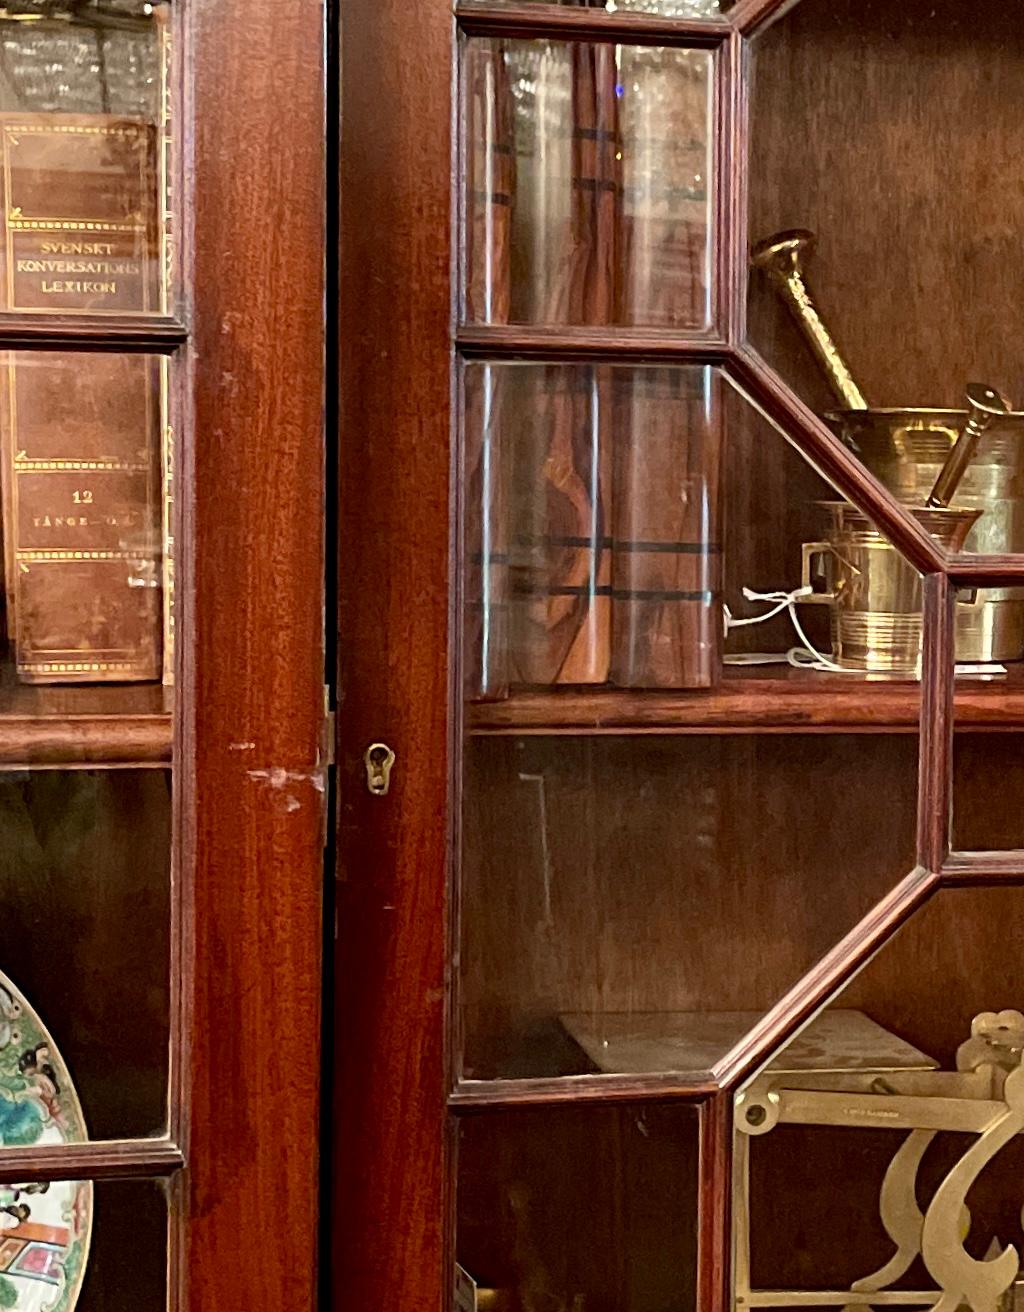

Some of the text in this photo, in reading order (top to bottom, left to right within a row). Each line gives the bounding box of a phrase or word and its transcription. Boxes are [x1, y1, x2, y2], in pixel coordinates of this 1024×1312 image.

[40, 242, 117, 255] SVENSKT
[17, 260, 140, 274] KONVERSATIONS
[41, 280, 117, 294] LEXIKON
[72, 490, 94, 504] 12
